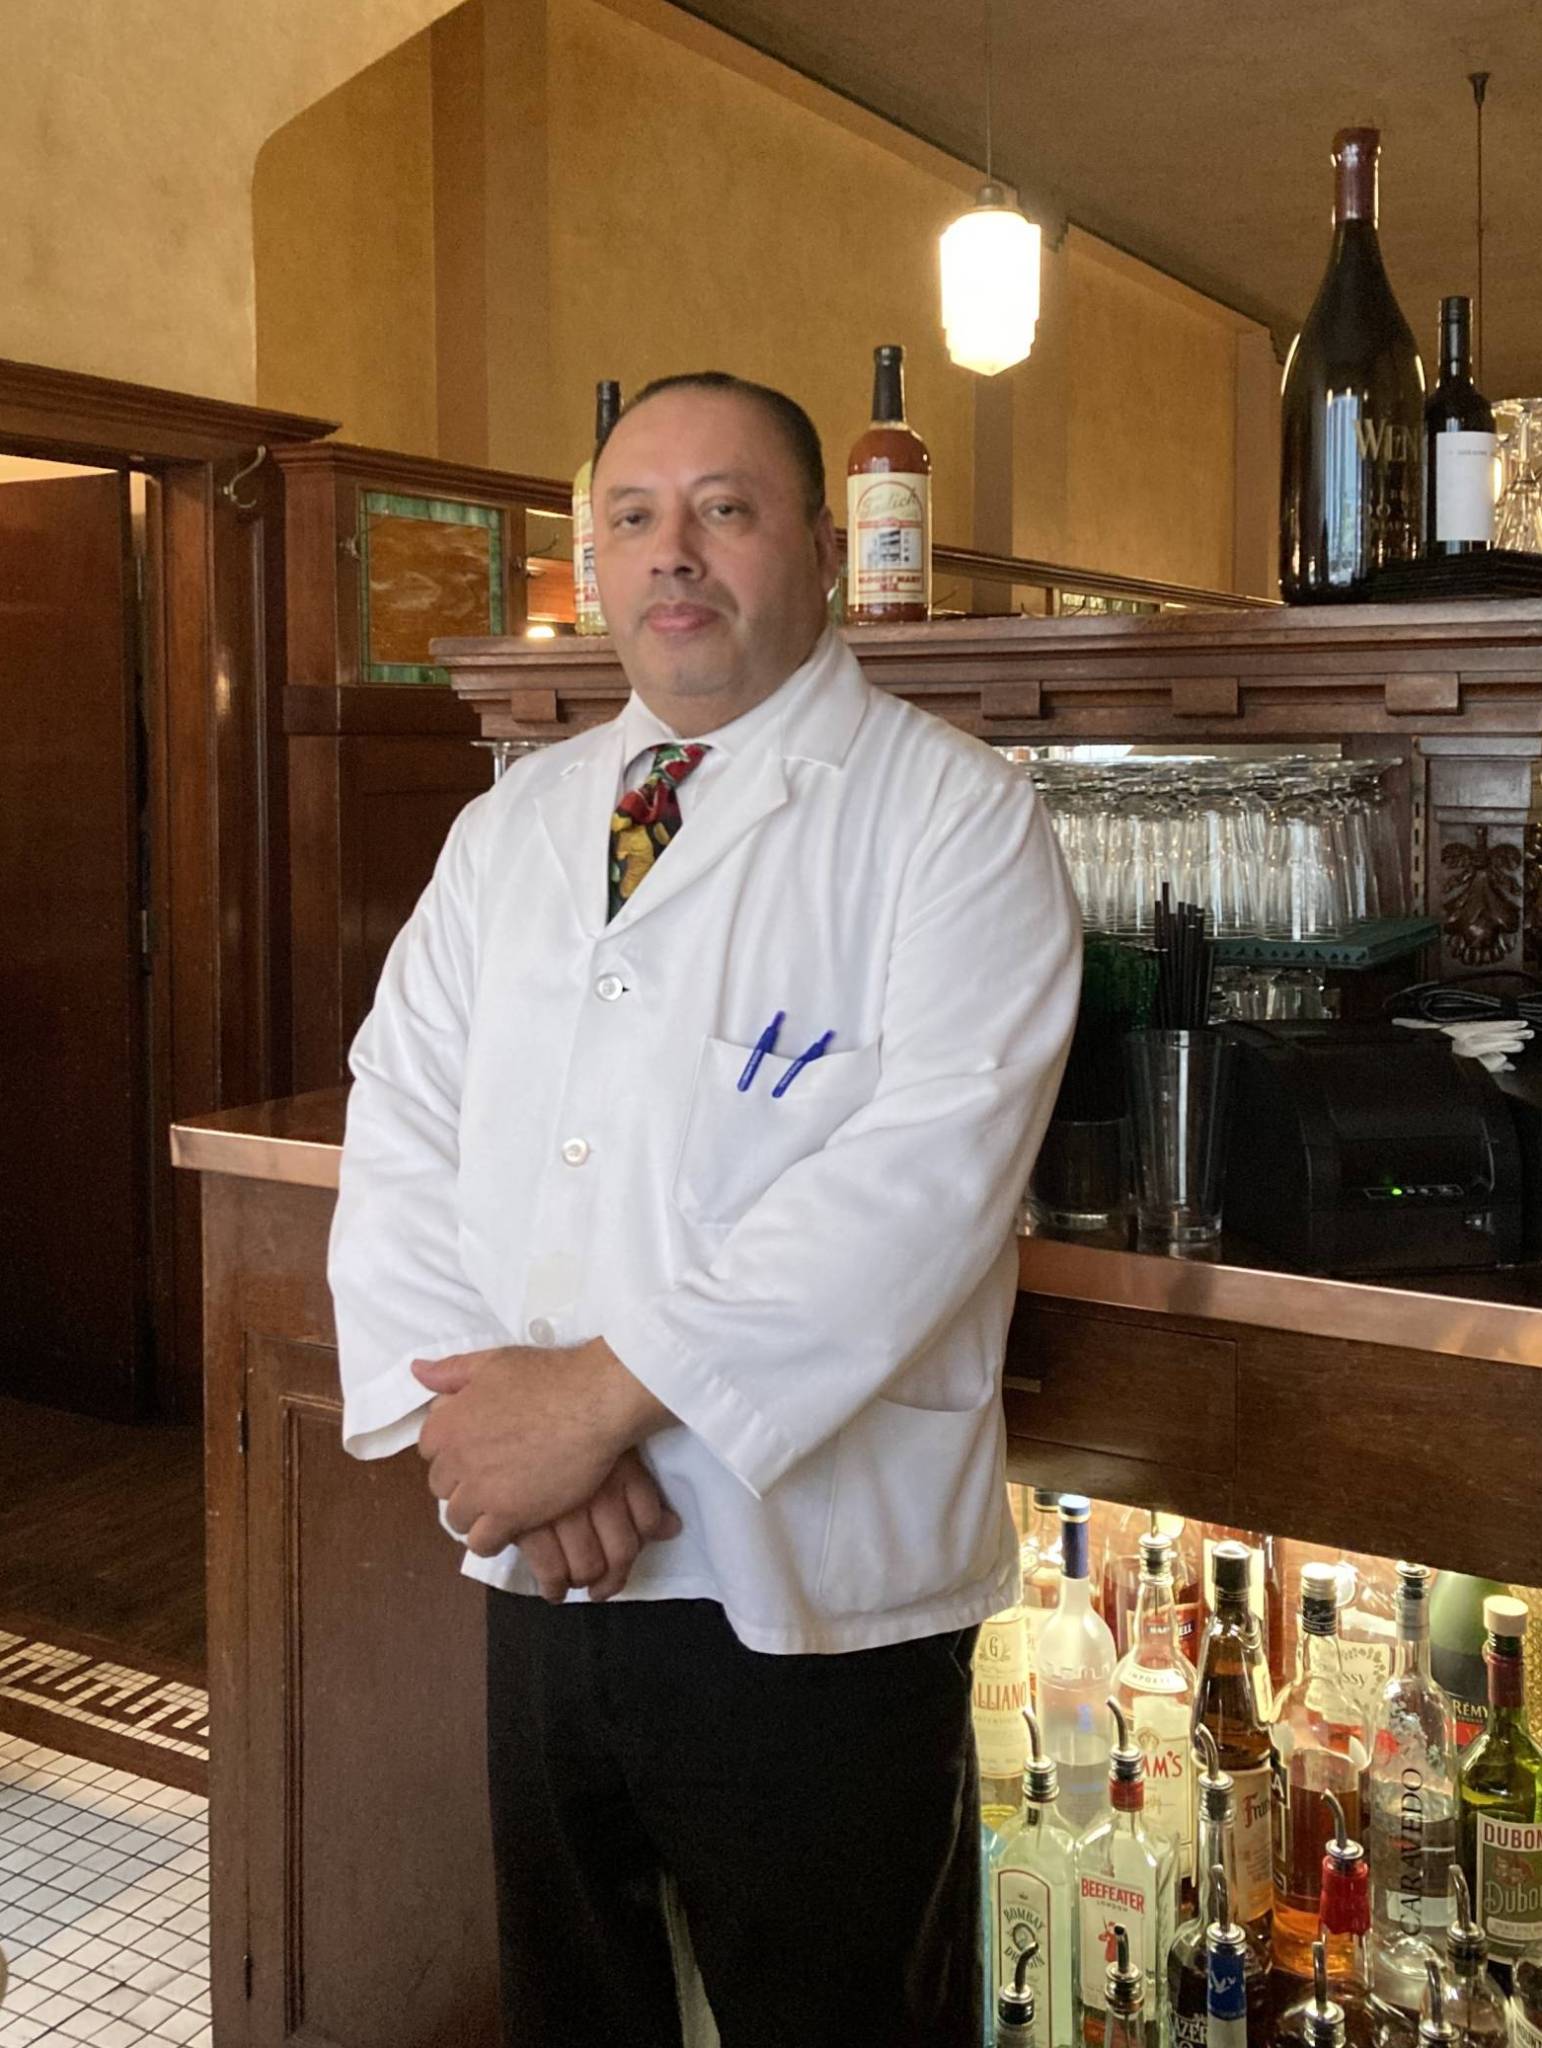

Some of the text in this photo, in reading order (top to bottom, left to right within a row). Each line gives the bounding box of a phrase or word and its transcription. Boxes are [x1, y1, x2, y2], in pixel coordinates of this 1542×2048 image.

[1400, 1767, 1424, 1937] CARAVEDO
[1081, 1878, 1145, 1914] BEEFEATER
[1003, 1905, 1045, 1931] BOMBAY
